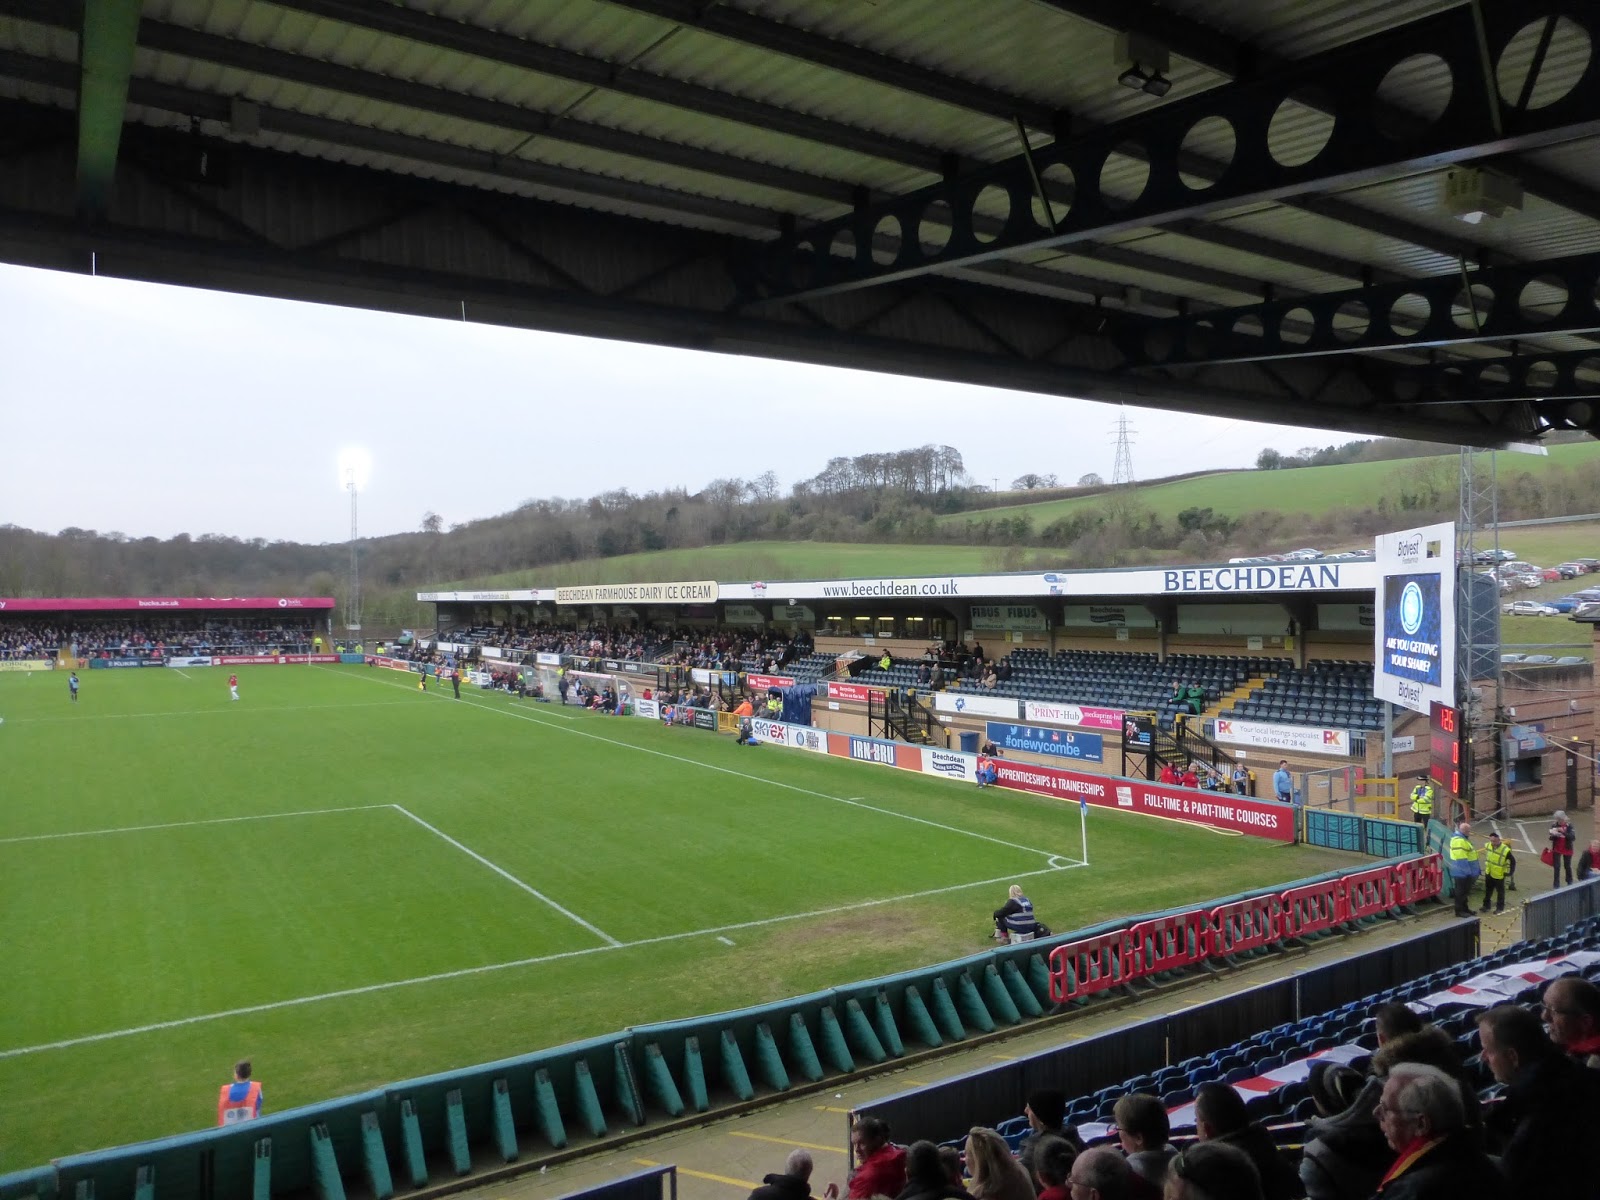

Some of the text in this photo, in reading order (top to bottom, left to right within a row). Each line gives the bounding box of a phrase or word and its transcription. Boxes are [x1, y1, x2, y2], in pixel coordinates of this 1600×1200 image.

[1398, 540, 1419, 557] Bidvest
[1164, 565, 1340, 592] BEECHDEAN
[558, 585, 711, 601] BEECHDEAN FARMHOUSE DAIRY ICE CREAM
[823, 579, 958, 596] www.beechdean.co.uk
[1397, 639, 1410, 651] YOU
[1410, 641, 1438, 656] GETTING
[1398, 682, 1420, 702] Bidvest
[1034, 707, 1080, 721] PRINT-Hub
[1441, 708, 1455, 732] 126
[1239, 725, 1254, 733] Your
[1269, 729, 1291, 739] lettings
[1291, 731, 1320, 740] specialist
[1005, 739, 1080, 756] #onewycombe
[1251, 735, 1262, 743] Tel:
[1263, 736, 1280, 745] 01494
[1281, 738, 1289, 746] 47
[1298, 740, 1307, 748] 46
[932, 751, 965, 764] Beechdean
[997, 768, 1050, 788] APPRENTICESHIPS
[1051, 778, 1057, 789] &
[1057, 778, 1105, 797] TRAINEESHIPS
[1144, 794, 1181, 812] FULL-TIME
[1183, 800, 1189, 813] &
[1191, 802, 1235, 821] PART-TIME
[1236, 809, 1277, 829] COURSES
